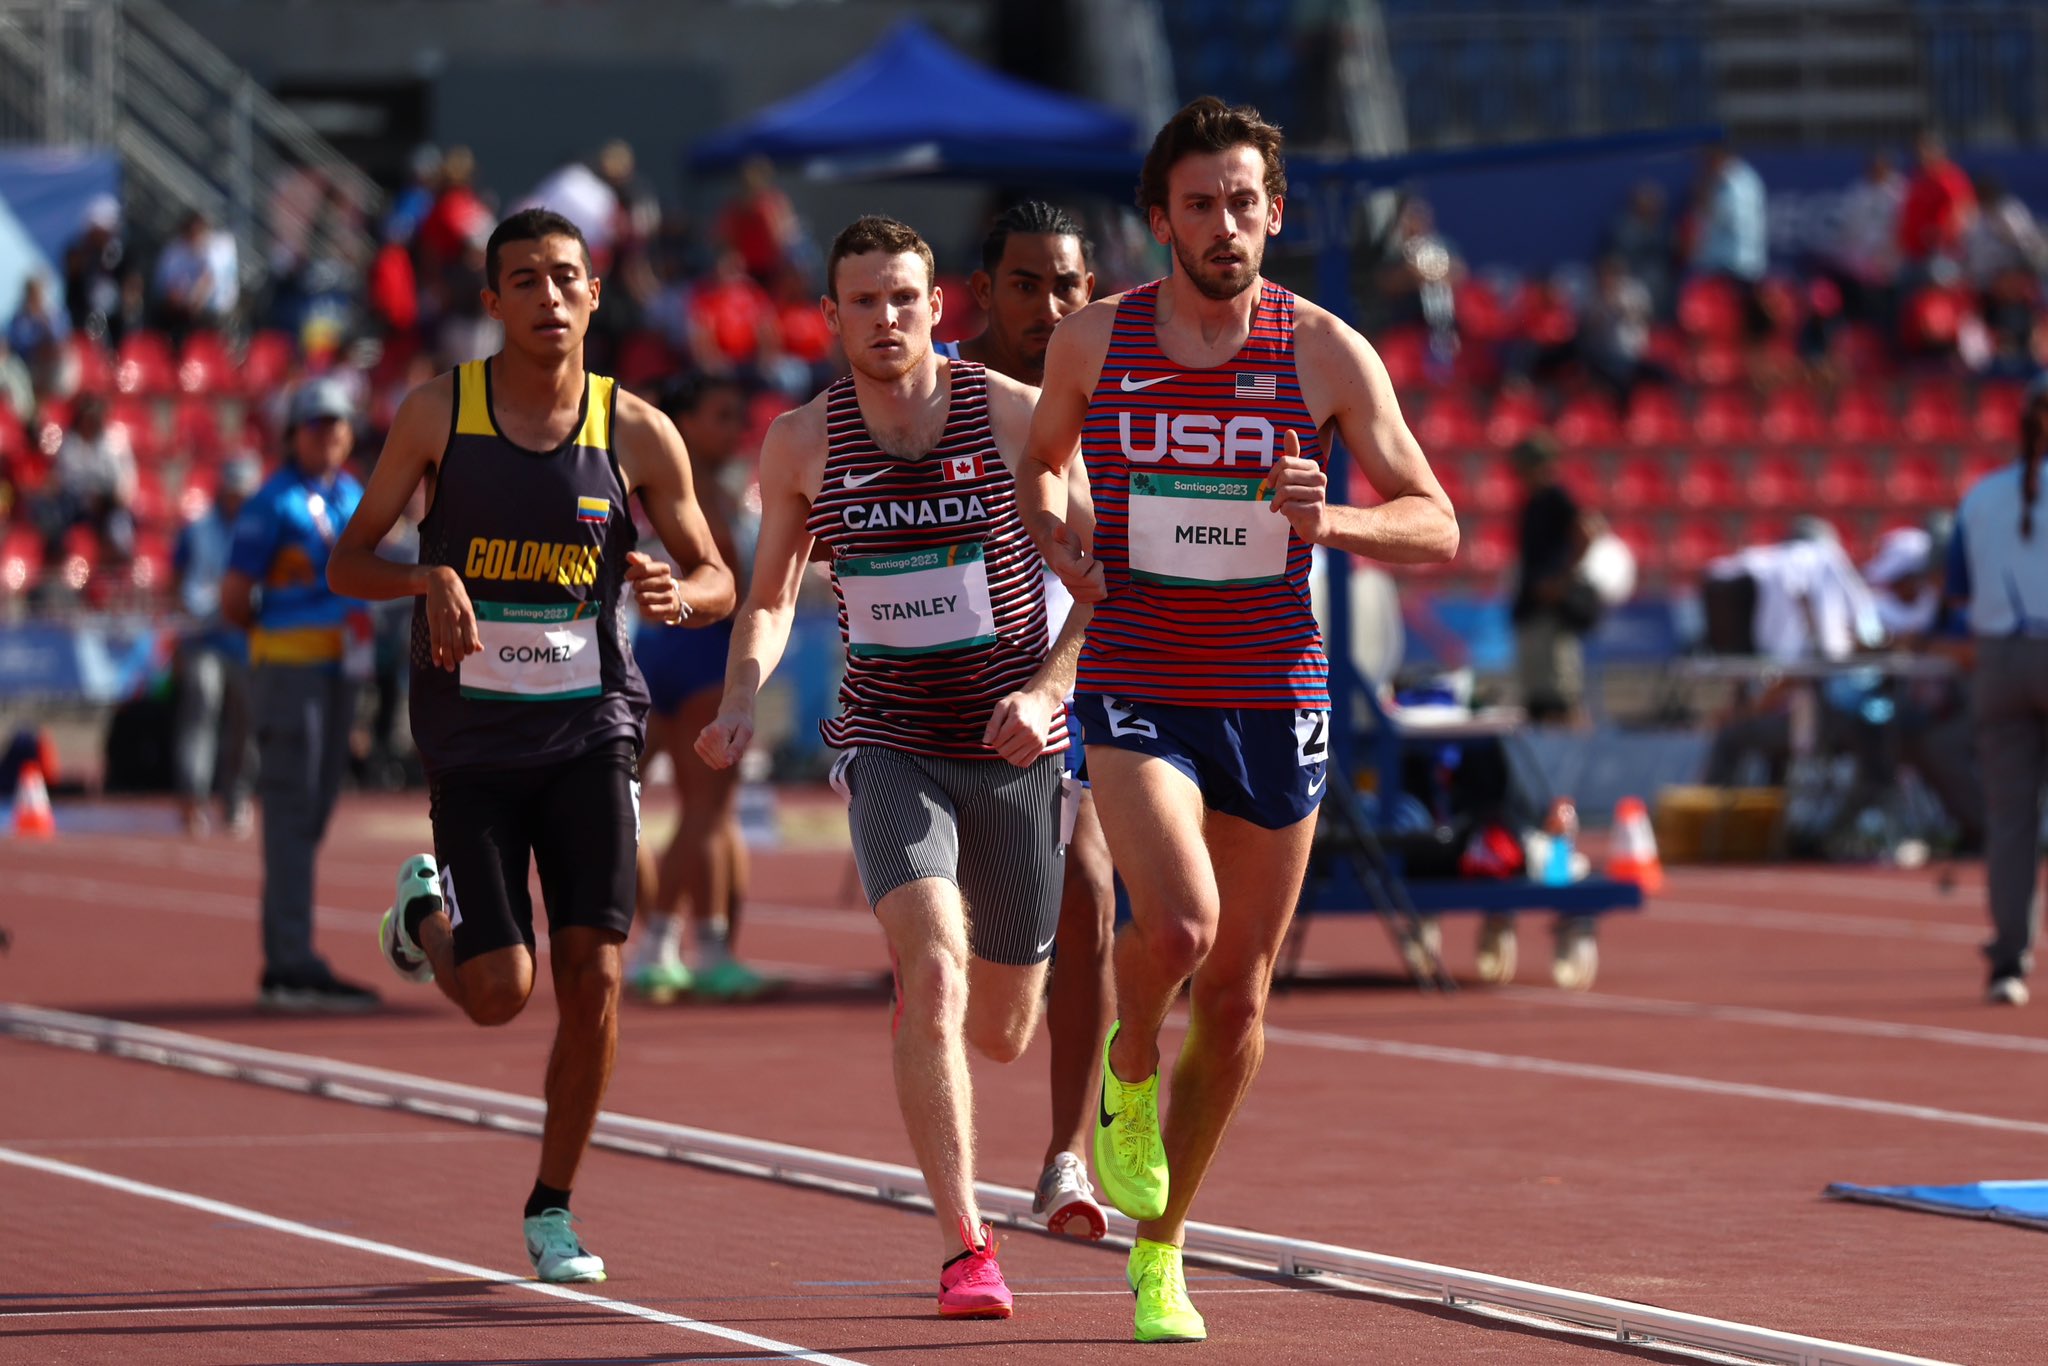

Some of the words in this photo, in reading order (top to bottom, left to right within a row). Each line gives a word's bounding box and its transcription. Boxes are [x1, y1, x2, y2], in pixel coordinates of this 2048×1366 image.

[1119, 411, 1275, 467] USA
[842, 494, 988, 530] CANADA
[1175, 525, 1247, 546] MERLE
[465, 537, 601, 586] COLOMBIA
[871, 595, 957, 621] STANLEY
[499, 645, 571, 663] GOMEZ
[1300, 709, 1326, 757] 2
